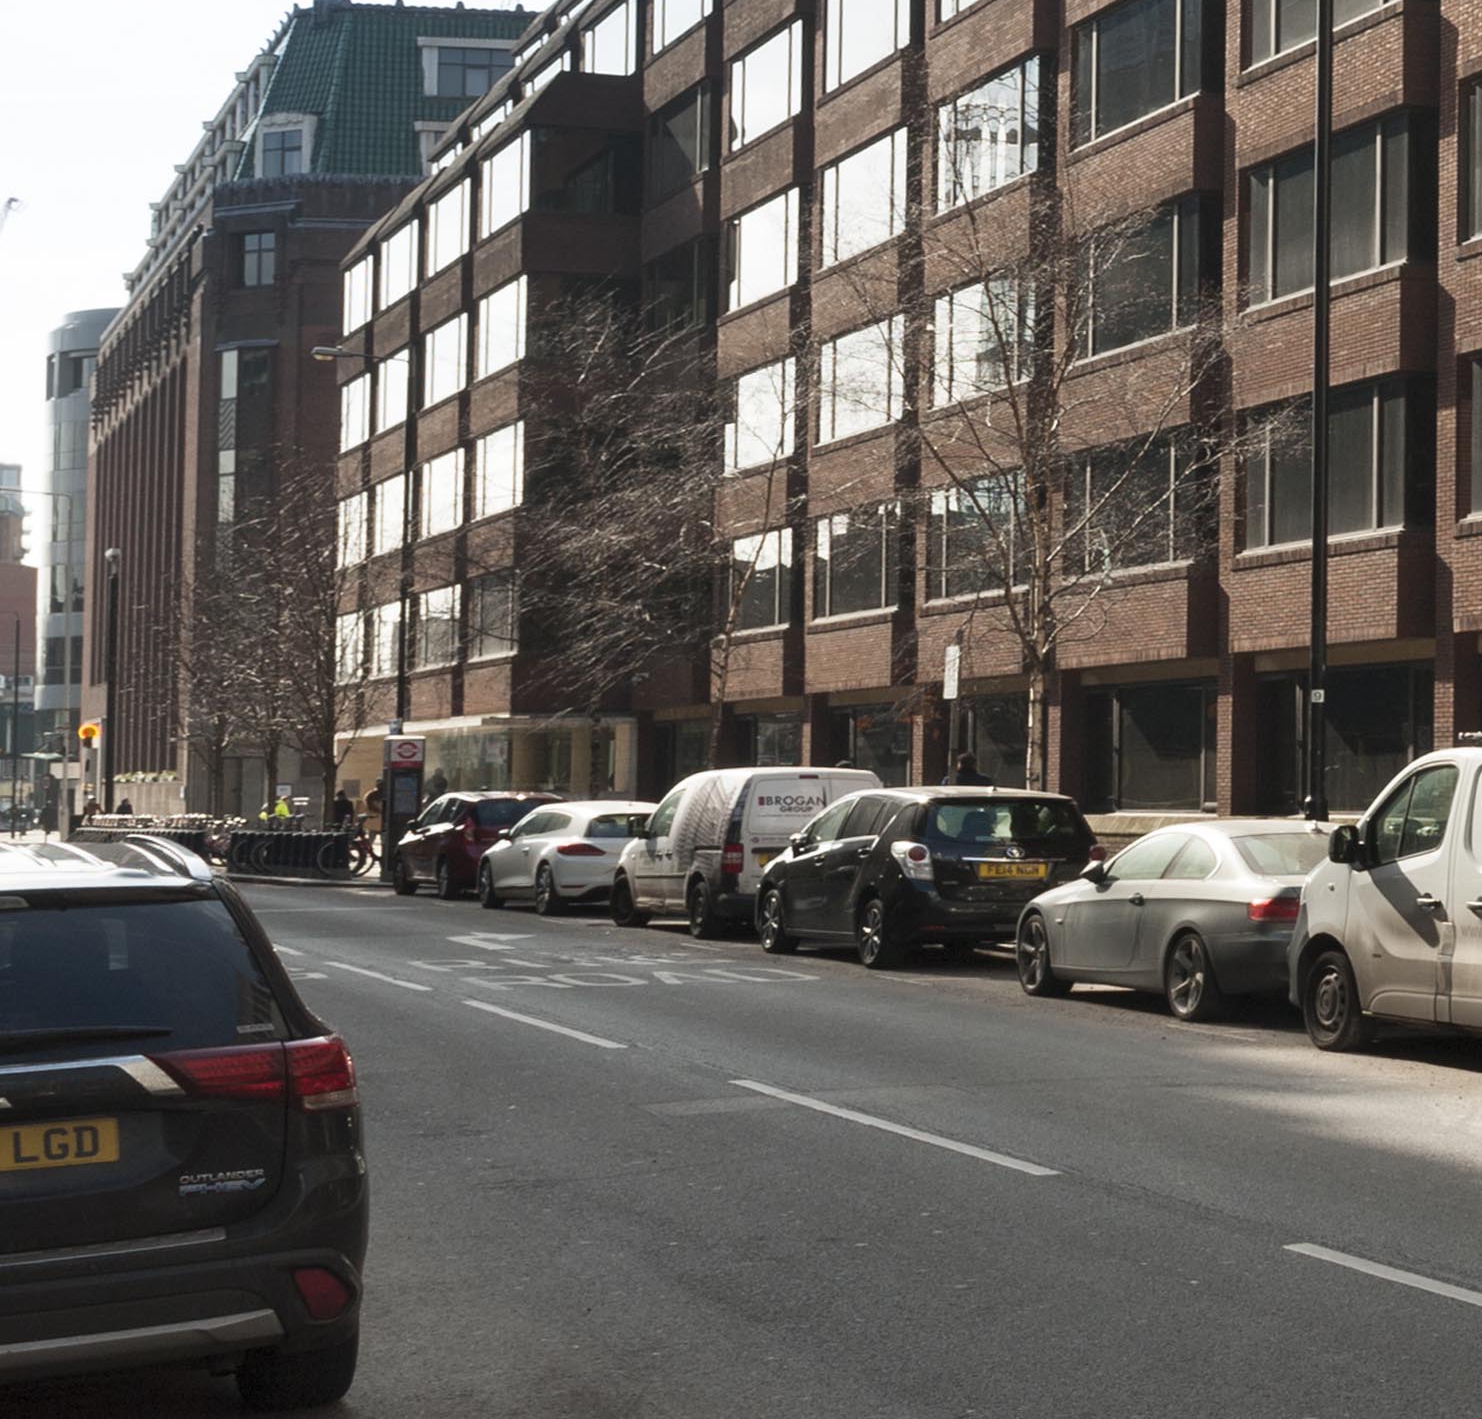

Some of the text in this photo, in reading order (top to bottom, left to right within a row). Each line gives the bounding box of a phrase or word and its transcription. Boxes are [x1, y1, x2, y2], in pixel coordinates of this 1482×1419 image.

[766, 795, 828, 807] BROGAN
[461, 968, 820, 990] ROAD
[13, 1126, 99, 1163] LGD
[179, 1168, 265, 1185] OUTLANDER
